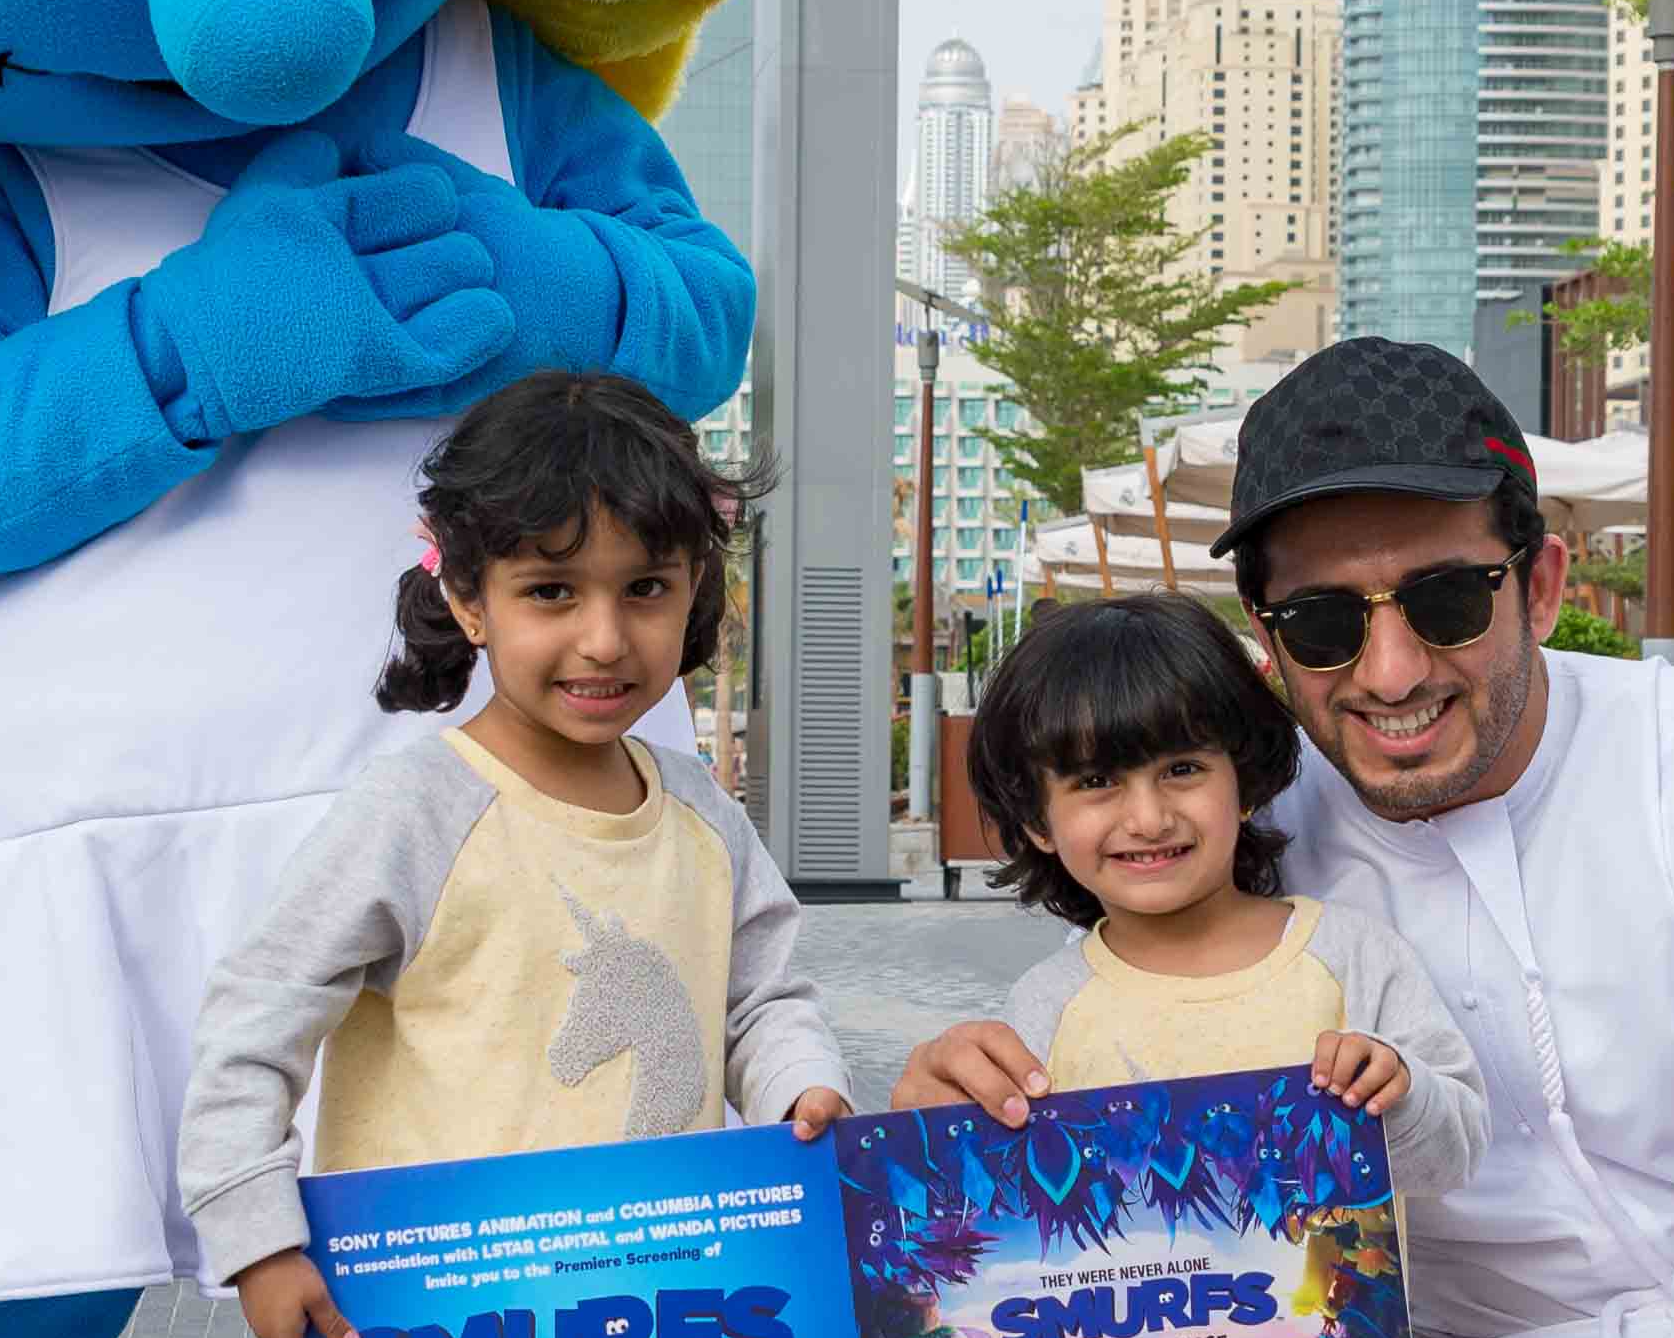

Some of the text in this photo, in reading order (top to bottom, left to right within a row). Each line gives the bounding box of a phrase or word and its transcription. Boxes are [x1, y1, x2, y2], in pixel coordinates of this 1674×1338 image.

[328, 1184, 804, 1253] SONY PICTURES ANIMATION and COLUMBIA PICTURES
[354, 1251, 440, 1274] association
[442, 1246, 478, 1264] with
[482, 1239, 535, 1260] LSTAR
[538, 1230, 610, 1254] CAPITAL
[615, 1227, 645, 1245] and
[649, 1218, 715, 1241] WANDA
[719, 1208, 802, 1232] PICTURES
[472, 1269, 499, 1288] you
[503, 1266, 520, 1281] to
[523, 1262, 551, 1278] the
[554, 1255, 622, 1274] Premiere
[626, 1247, 701, 1266] Screening
[704, 1241, 723, 1258] of
[1040, 1256, 1211, 1289] THEY WERE NEVER ALONE
